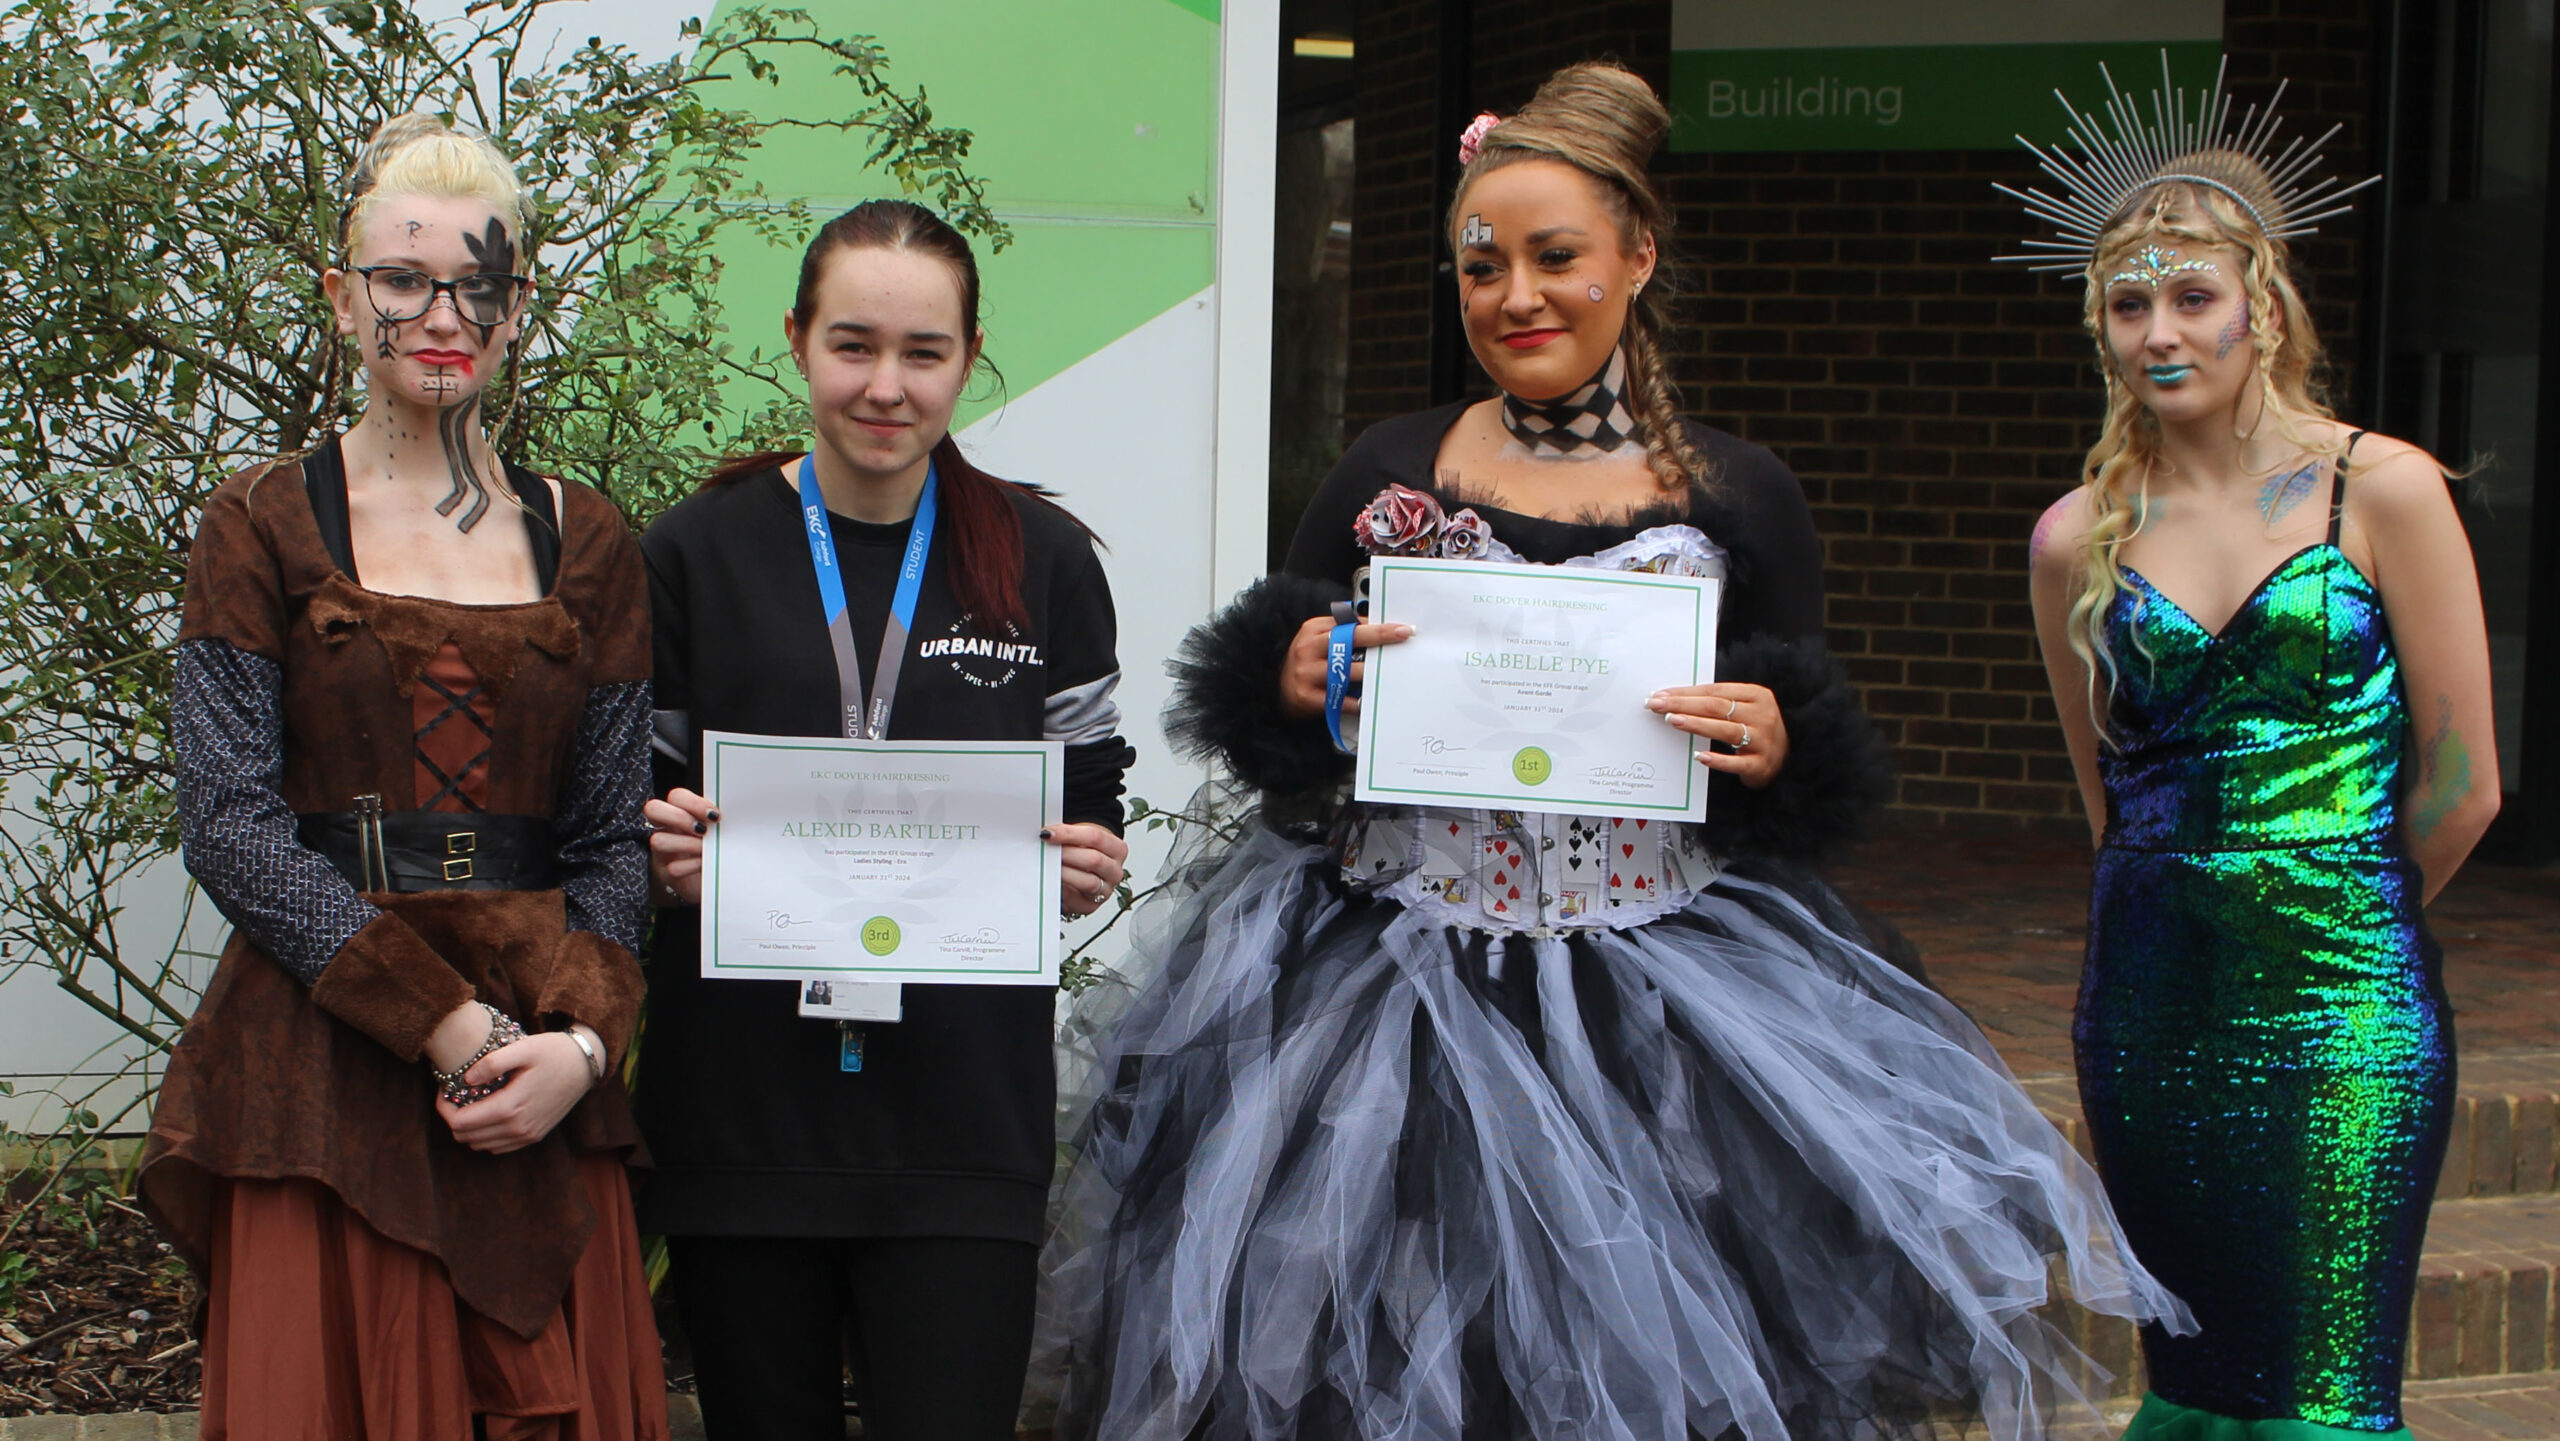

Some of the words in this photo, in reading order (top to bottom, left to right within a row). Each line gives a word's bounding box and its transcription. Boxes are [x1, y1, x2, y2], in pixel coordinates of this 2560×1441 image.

[1708, 76, 1902, 125] Building
[806, 505, 822, 534] EKC
[905, 529, 925, 580] STUDENT
[1473, 594, 1494, 604] EKC
[1496, 596, 1530, 606] DOVER
[1532, 599, 1607, 611] HAIRDRESSING
[920, 637, 994, 658] URBAN
[996, 641, 1044, 665] INTL.
[1331, 643, 1346, 674] EKC
[1464, 651, 1563, 671] ISABELLE
[1570, 657, 1610, 675] PYE
[964, 672, 982, 687] SPEC
[847, 704, 859, 737] STUD
[811, 771, 831, 779] EKC
[834, 772, 870, 781] DOVER
[872, 773, 950, 782] HAIRDRESSING
[1520, 759, 1539, 771] 1st
[782, 821, 862, 837] ALEXID
[870, 823, 981, 840] BARTLETT
[868, 929, 890, 941] 3rd
